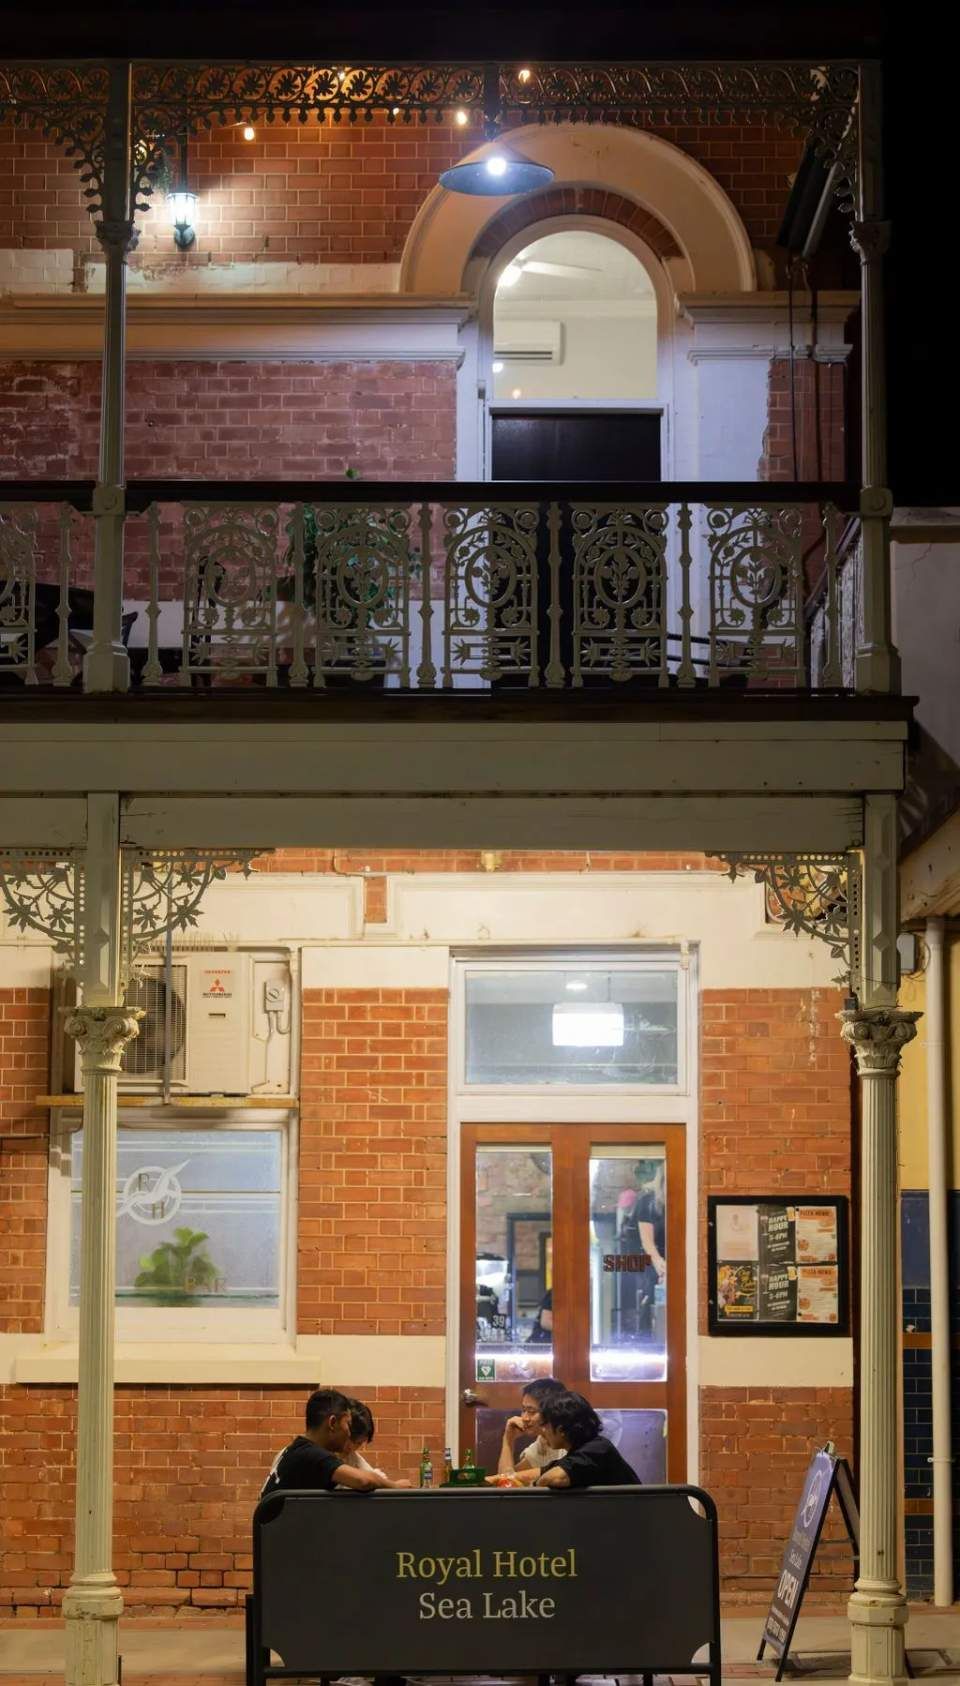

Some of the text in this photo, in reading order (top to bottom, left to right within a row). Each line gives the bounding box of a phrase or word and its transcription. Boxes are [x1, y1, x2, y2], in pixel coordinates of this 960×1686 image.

[151, 1200, 165, 1218] H
[603, 1254, 651, 1272] SHOP
[395, 1549, 578, 1585] Royal Hotel
[777, 1568, 799, 1609] OPEN
[419, 1590, 556, 1620] Sea Lake
